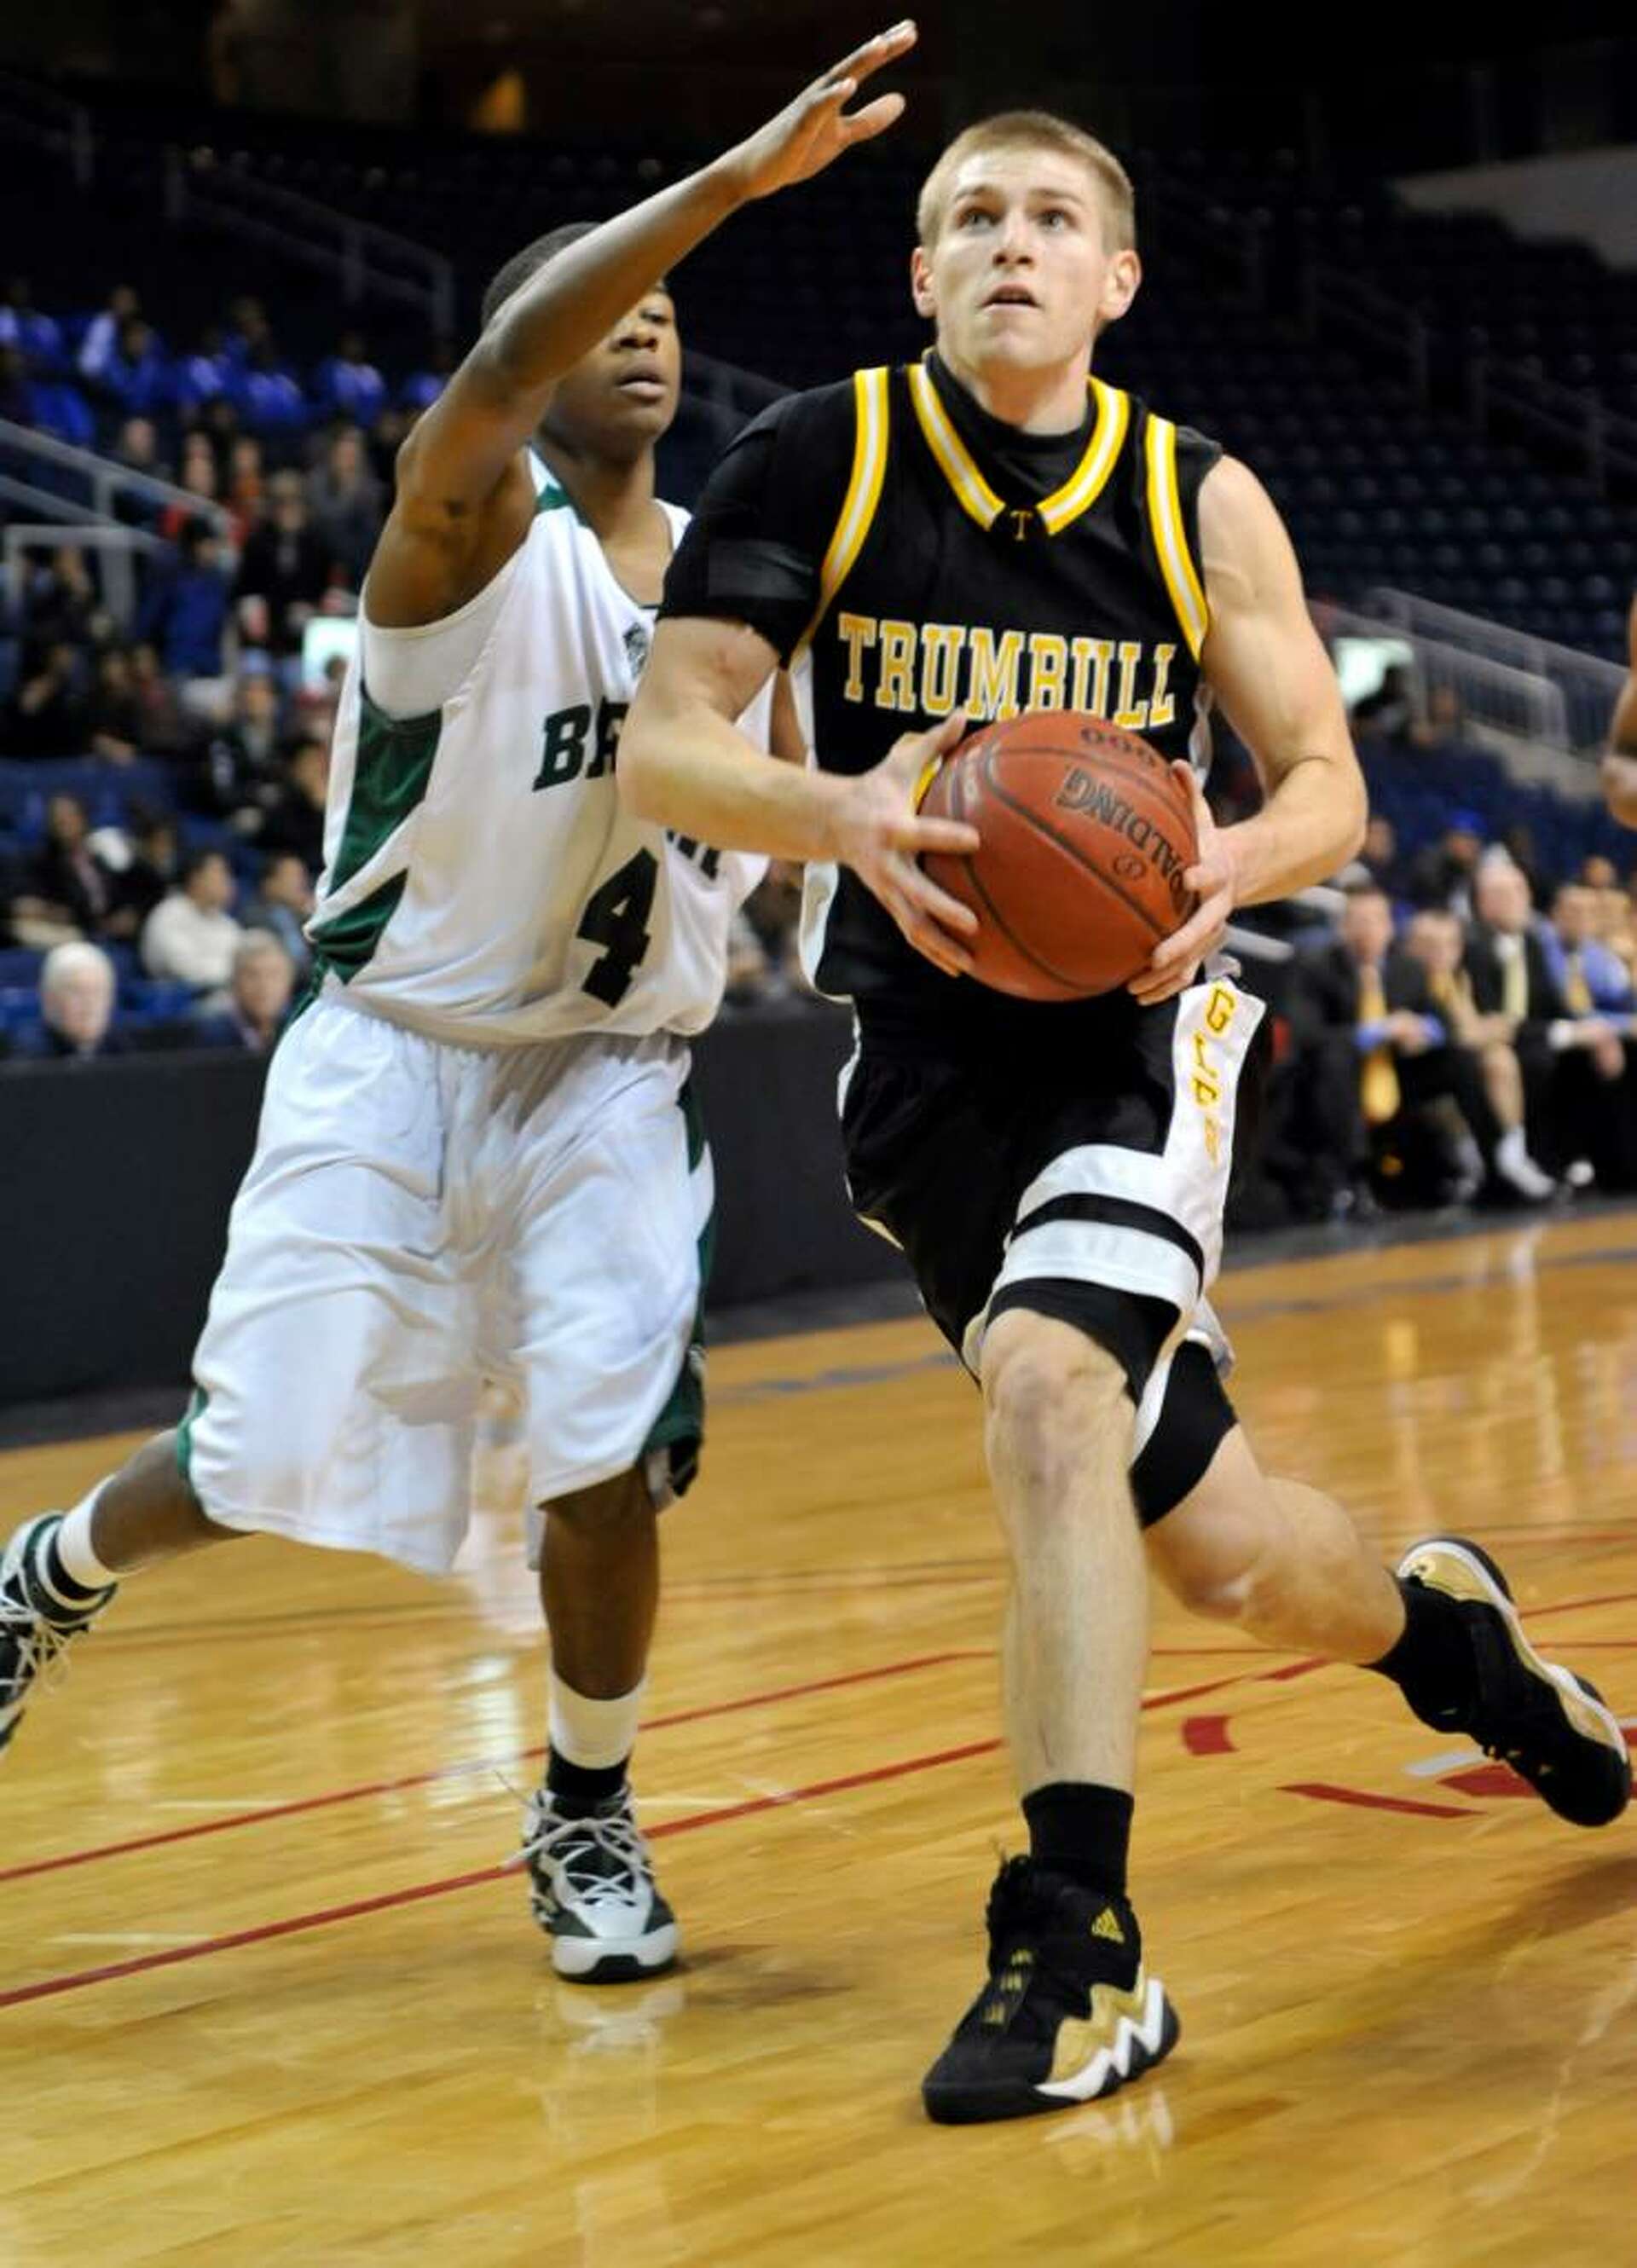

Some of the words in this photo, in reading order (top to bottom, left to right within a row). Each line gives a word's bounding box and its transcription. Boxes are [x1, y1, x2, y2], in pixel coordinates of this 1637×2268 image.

[1009, 511, 1033, 541] T
[839, 612, 1176, 729] TRUMBULL
[577, 847, 658, 1010] 4
